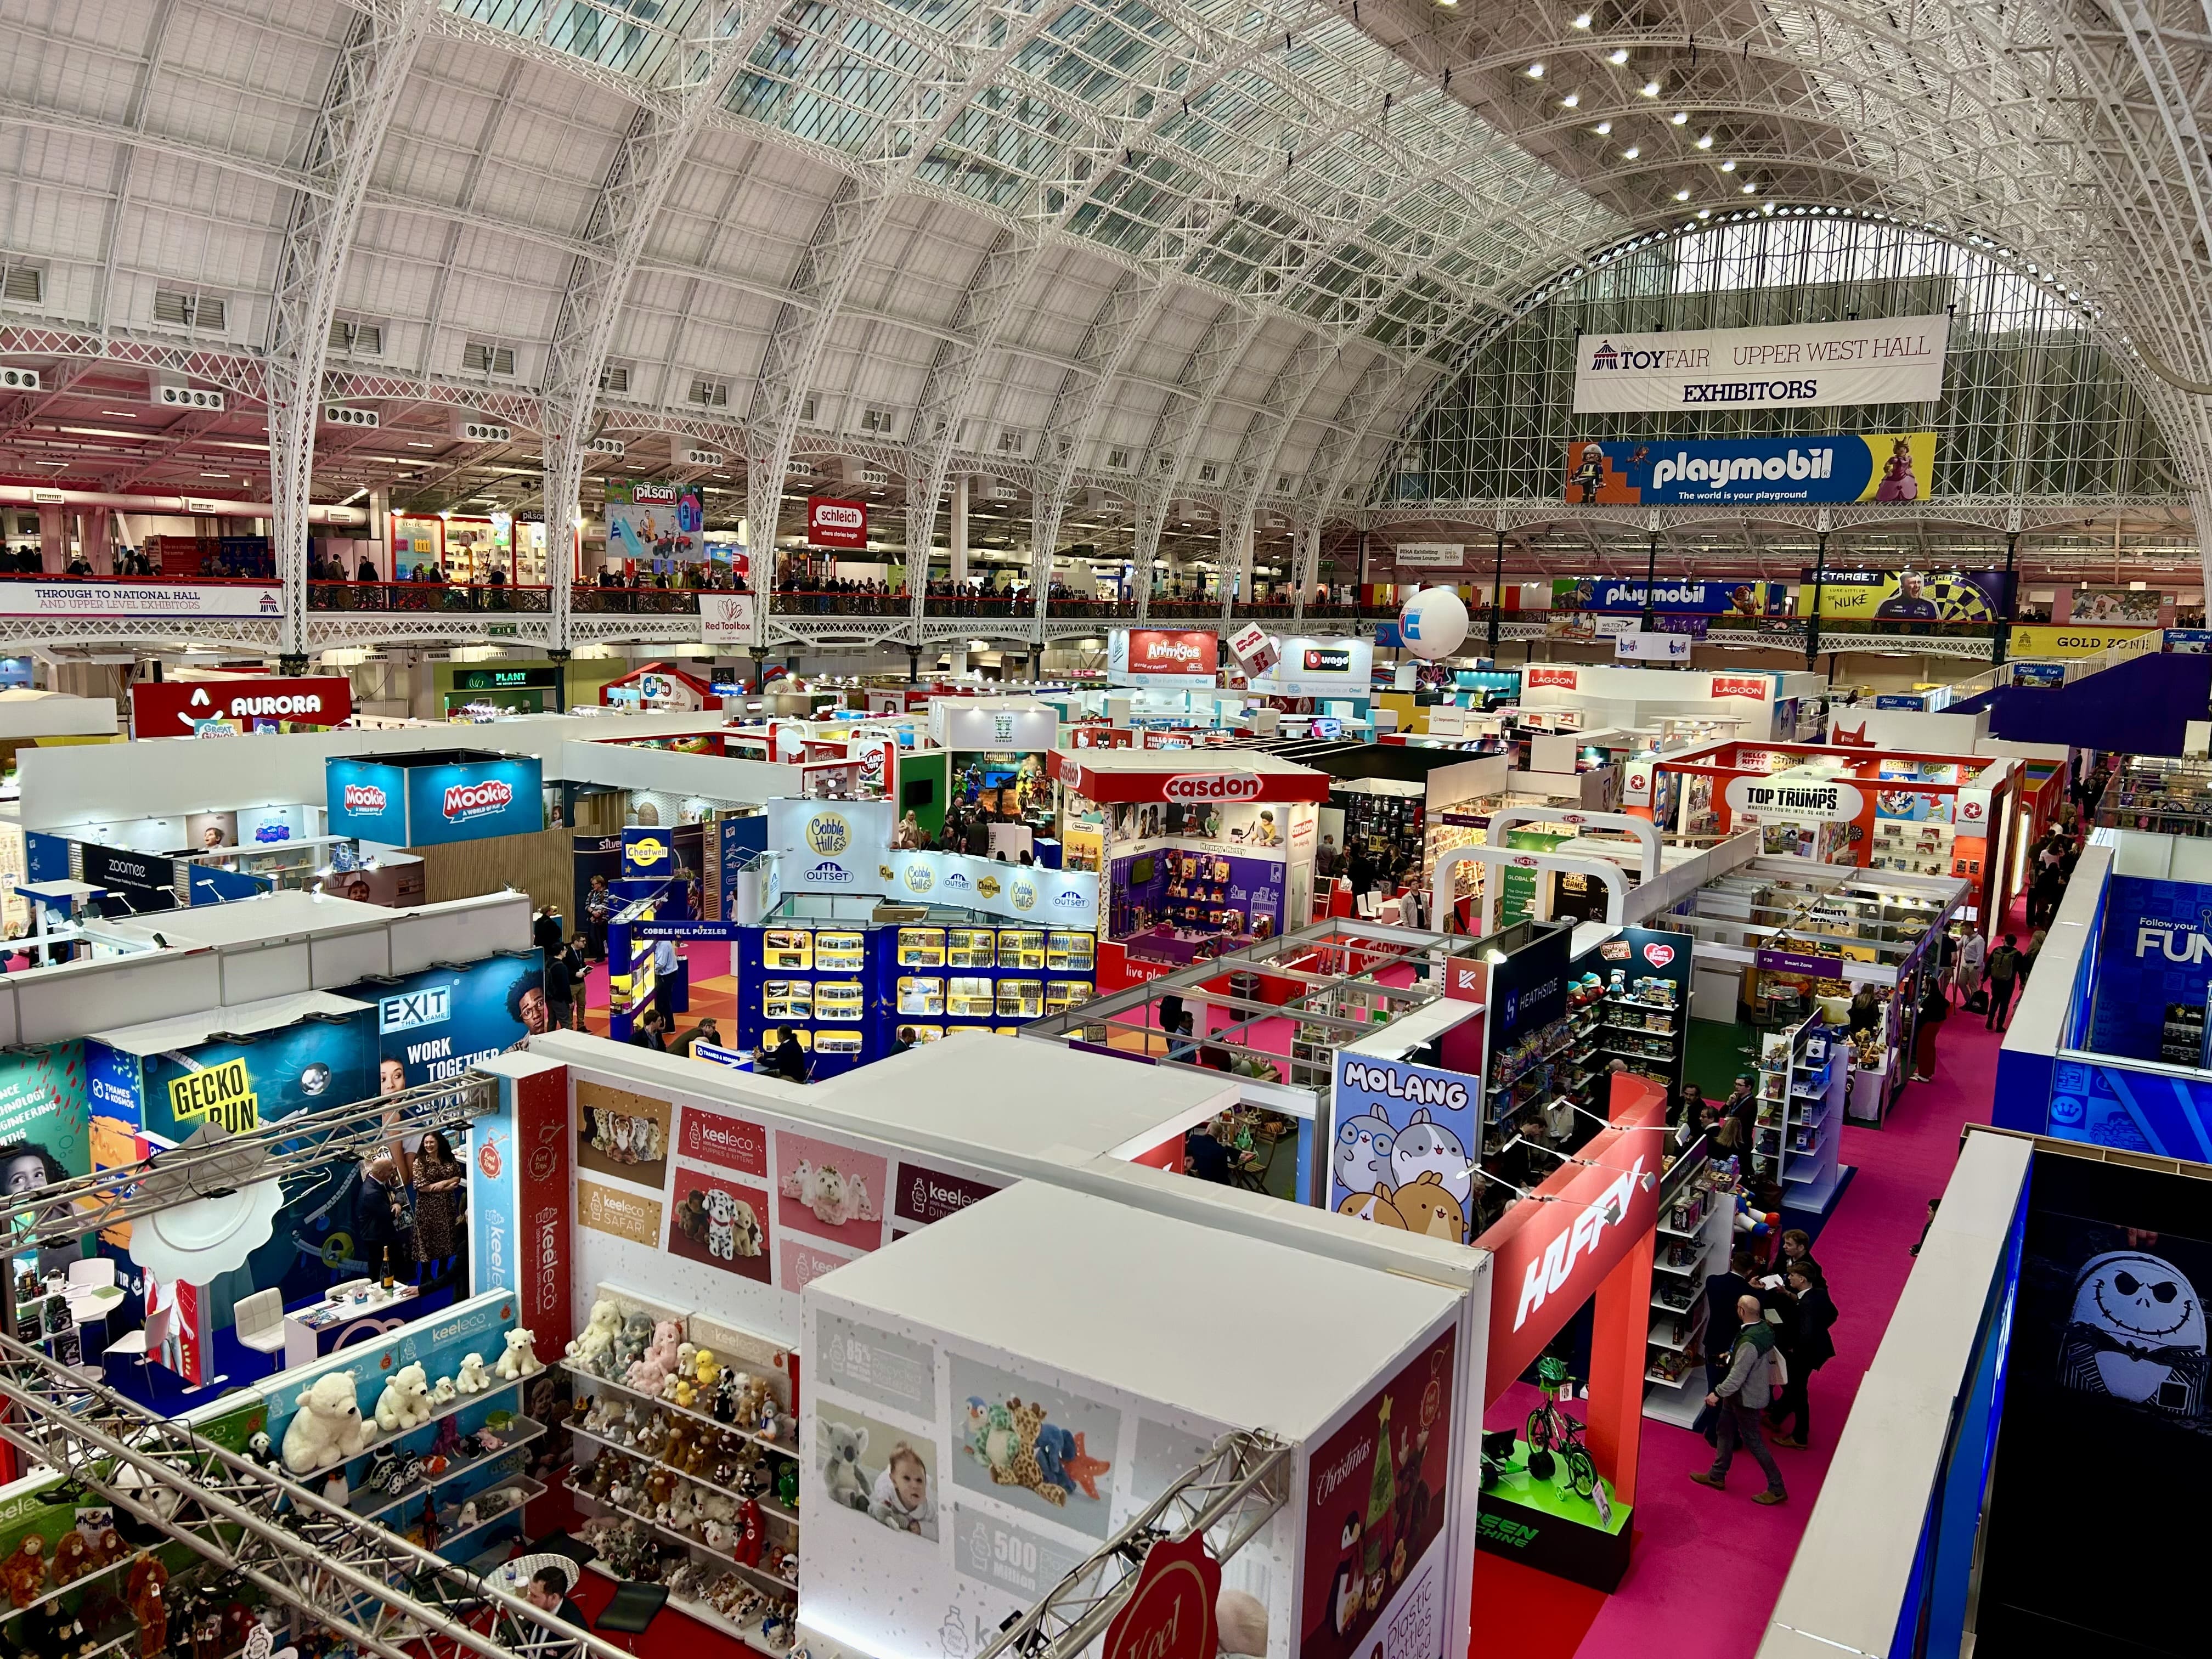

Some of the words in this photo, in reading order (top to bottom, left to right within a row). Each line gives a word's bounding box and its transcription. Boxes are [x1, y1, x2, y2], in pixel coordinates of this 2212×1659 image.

[1733, 343, 1799, 365] UPPER
[1807, 340, 1867, 362] WEST
[1874, 336, 1931, 358] HALL
[1682, 380, 1817, 403] EXHIBITORS
[1652, 448, 1833, 489] playmobil
[636, 484, 673, 499] pilsan
[1734, 493, 1752, 501] your
[1756, 491, 1807, 501] playground
[821, 509, 857, 523] schleich
[1829, 572, 1878, 583] TARGET
[35, 589, 92, 599] THROUGH
[95, 590, 110, 598] TO
[114, 590, 171, 600] NATIONAL
[173, 591, 200, 600] HALL
[1606, 584, 1705, 605] playmobil
[1835, 594, 1870, 610] NUKE
[40, 599, 65, 609] AND
[69, 600, 104, 609] UPPER
[107, 600, 139, 609] LEVEL
[142, 600, 200, 610] EXHIBITORS
[705, 622, 720, 630] Red
[721, 622, 751, 631] Toolbox
[1147, 640, 1201, 662] Animigos
[2057, 637, 2101, 648] GOLD
[2107, 637, 2151, 651] ZONE
[496, 673, 526, 681] PLANT
[1531, 676, 1574, 685] LAGOON
[1716, 686, 1762, 695] LAGOON
[231, 695, 321, 716] AURORA
[1886, 760, 1914, 769] SONIC
[1165, 775, 1259, 798] casdon
[347, 788, 385, 805] Mookie
[445, 783, 510, 810] Mookie
[1747, 787, 1774, 804] TOP
[1778, 788, 1838, 810] TRUMPS
[278, 827, 288, 838] Pig
[811, 818, 844, 837] Cobble
[1291, 821, 1314, 836] casdon
[627, 845, 667, 857] Cheatwell
[816, 835, 833, 853] Hill
[1133, 844, 1146, 853] dyson
[1200, 842, 1223, 854] Henry
[1227, 846, 1246, 856] Hetty
[109, 858, 145, 877] zoomee
[908, 865, 930, 878] Cobble
[911, 878, 922, 890] Hill
[978, 881, 1001, 893] Cheatwell
[1013, 881, 1032, 896] Cobble
[1566, 880, 1584, 890] GAME
[1015, 895, 1026, 908] Hill
[1812, 906, 1847, 918] MIGHTY
[2140, 917, 2172, 929] Follow
[2173, 922, 2198, 932] your
[1649, 952, 1669, 962] Bears
[1652, 947, 1668, 956] Care
[1126, 964, 1143, 979] live
[1519, 977, 1558, 1011] HEATHSIDE
[384, 990, 447, 1024] EXIT
[401, 1019, 415, 1027] THE
[426, 1013, 446, 1021] GAME
[407, 1036, 451, 1064] WORK
[703, 1049, 719, 1058] THAMES
[104, 1083, 131, 1099] THAMES
[174, 1064, 244, 1114] GECKO
[1344, 1062, 1469, 1110] MOLANG
[110, 1094, 134, 1109] KOSMOS
[209, 1098, 255, 1133] RUN
[702, 1124, 753, 1151] keeleco
[483, 1150, 496, 1163] Keel
[535, 1153, 548, 1161] Keel
[702, 1146, 725, 1159] PUPPIES
[731, 1153, 754, 1165] KITTENS
[482, 1158, 497, 1171] Toys
[534, 1160, 548, 1171] Toys
[603, 1192, 644, 1217] keeleco
[603, 1217, 645, 1235] SAFARI
[1513, 1154, 1645, 1334] HUFFY
[542, 1220, 558, 1311] keeleco
[432, 1313, 486, 1342] keeleco
[847, 1339, 871, 1364] 85%
[1316, 1435, 1372, 1506] Christmas
[994, 1530, 1037, 1573] 500
[994, 1562, 1036, 1590] Million
